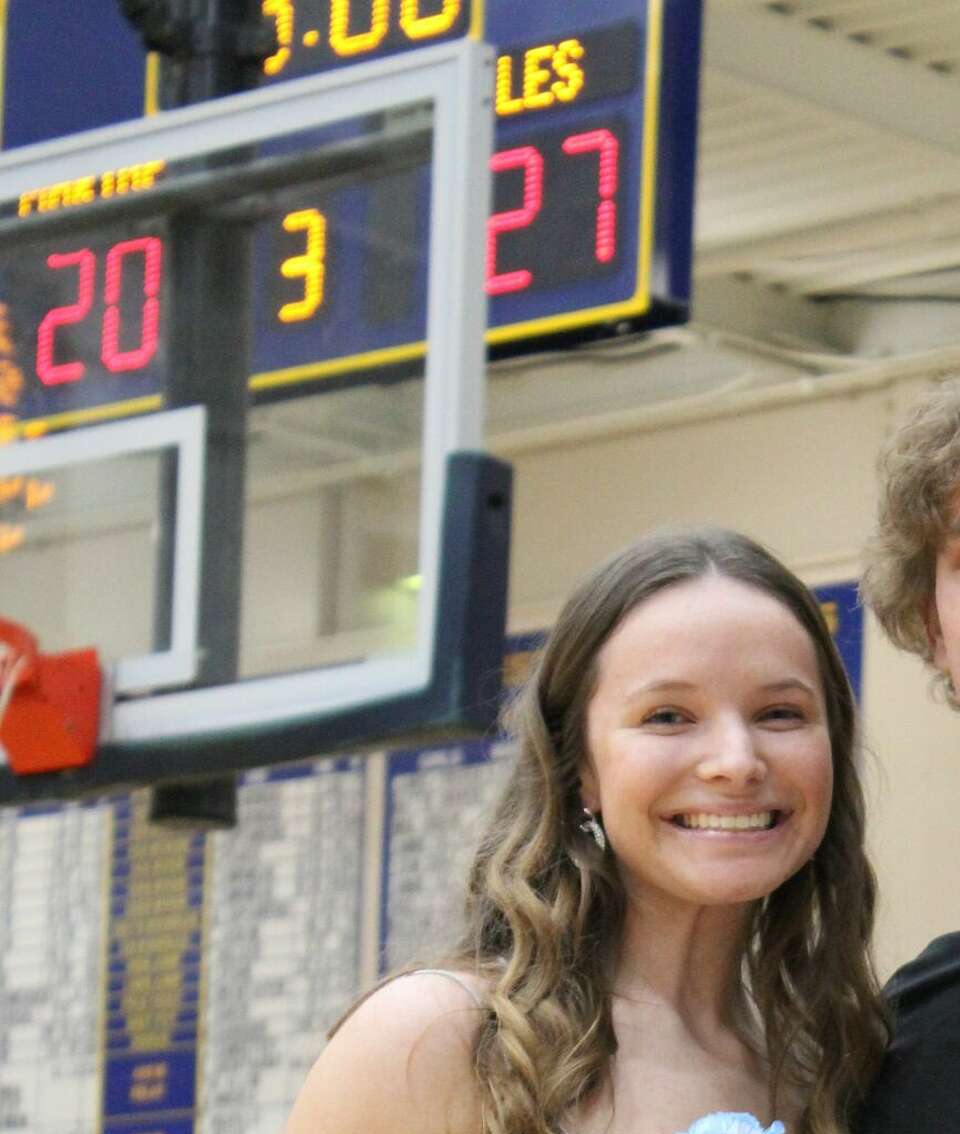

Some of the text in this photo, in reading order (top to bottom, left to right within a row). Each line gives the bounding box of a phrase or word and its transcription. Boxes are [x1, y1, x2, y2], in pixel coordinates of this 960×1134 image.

[278, 208, 326, 323] 3
[484, 129, 618, 295] 27
[36, 237, 162, 386] 20
